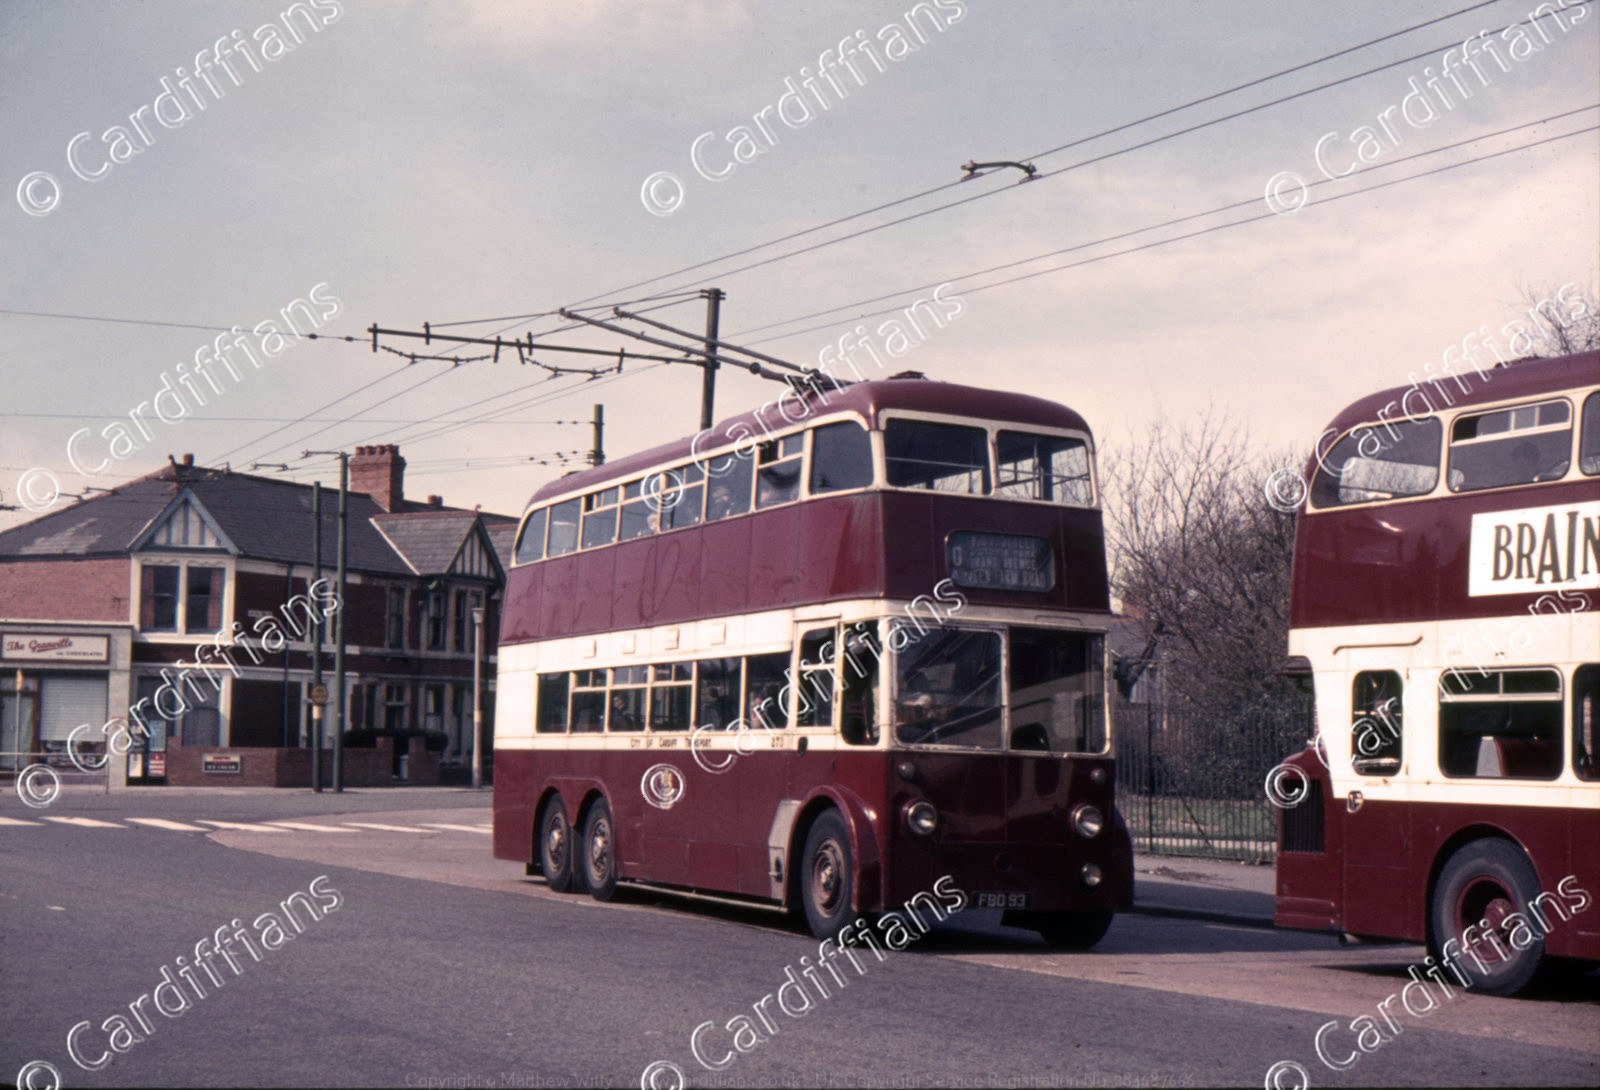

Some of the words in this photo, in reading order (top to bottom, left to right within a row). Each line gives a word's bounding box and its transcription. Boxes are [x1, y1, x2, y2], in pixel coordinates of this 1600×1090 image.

[6, 641, 25, 651] The
[28, 638, 73, 653] Granville
[1008, 893, 1026, 907] 93
